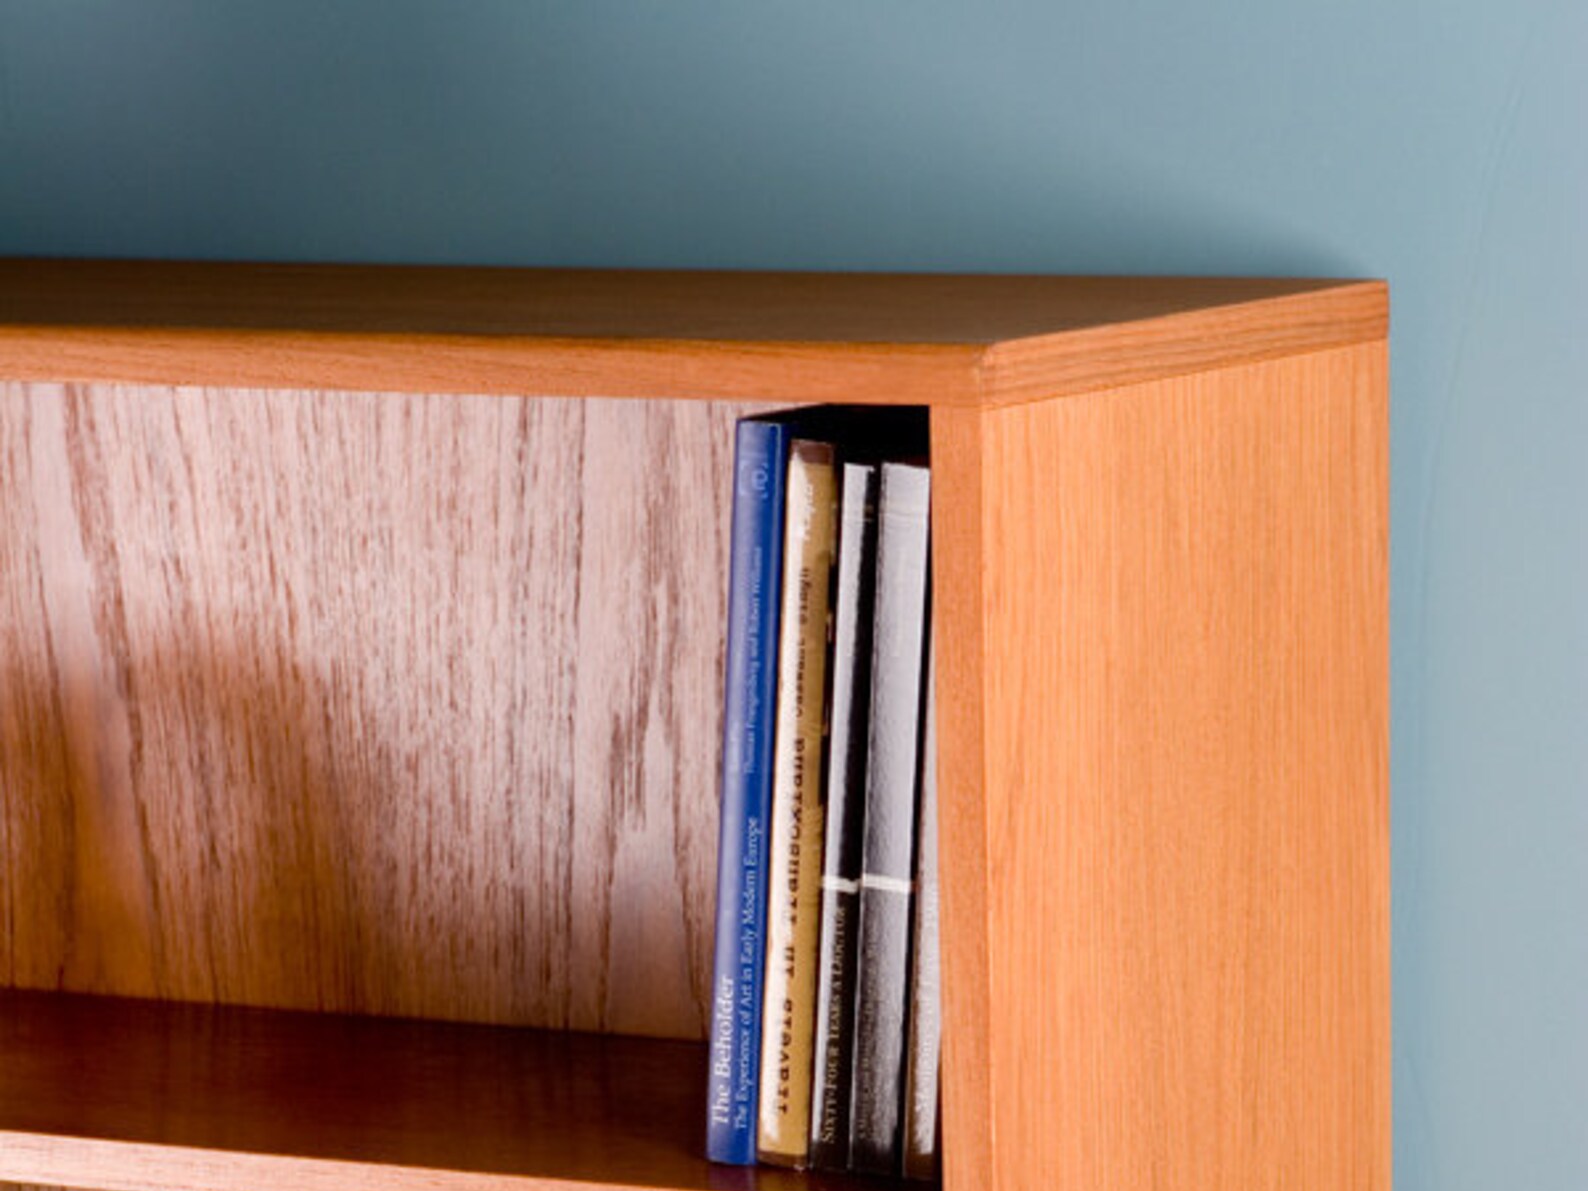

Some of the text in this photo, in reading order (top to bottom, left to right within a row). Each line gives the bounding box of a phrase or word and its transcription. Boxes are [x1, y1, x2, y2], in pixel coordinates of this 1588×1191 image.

[711, 975, 734, 1127] The Beholder
[734, 817, 762, 1130] The Experience of Art in Early Modern Europe
